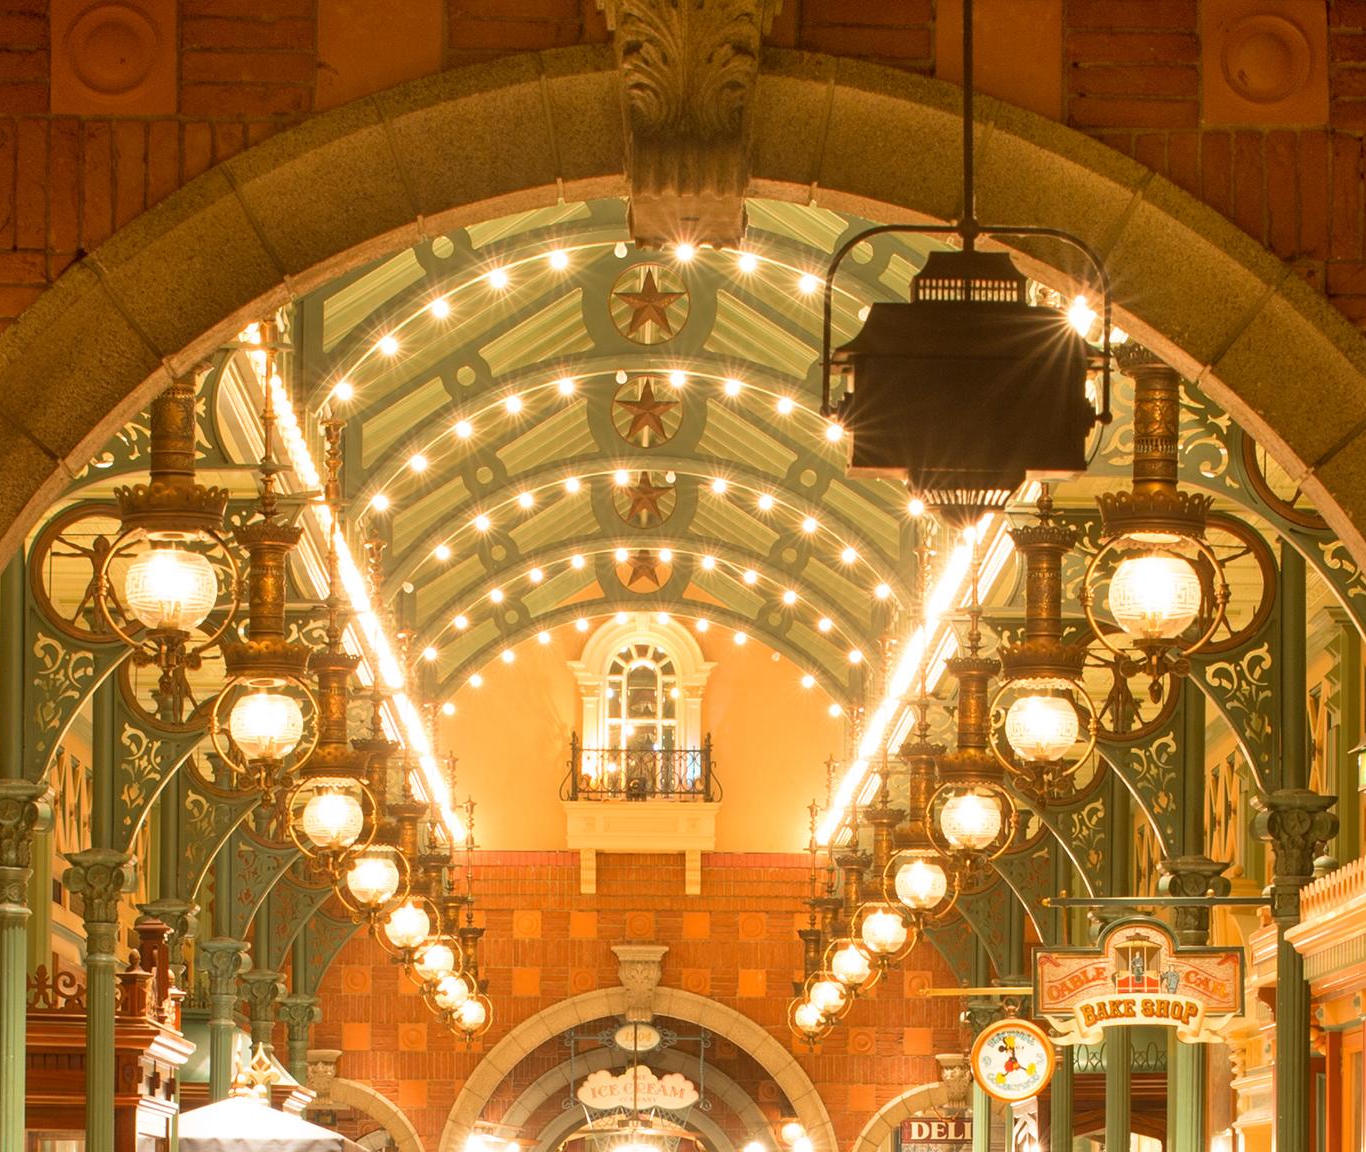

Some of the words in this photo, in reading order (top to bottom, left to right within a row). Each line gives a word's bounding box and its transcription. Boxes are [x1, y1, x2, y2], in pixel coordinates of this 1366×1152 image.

[1046, 966, 1108, 1001] CABLE
[1185, 969, 1230, 998] CAR
[1080, 999, 1137, 1028] BAKE
[1141, 998, 1199, 1026] SHOP
[591, 1084, 619, 1099] ICE
[910, 1121, 972, 1140] DELI
